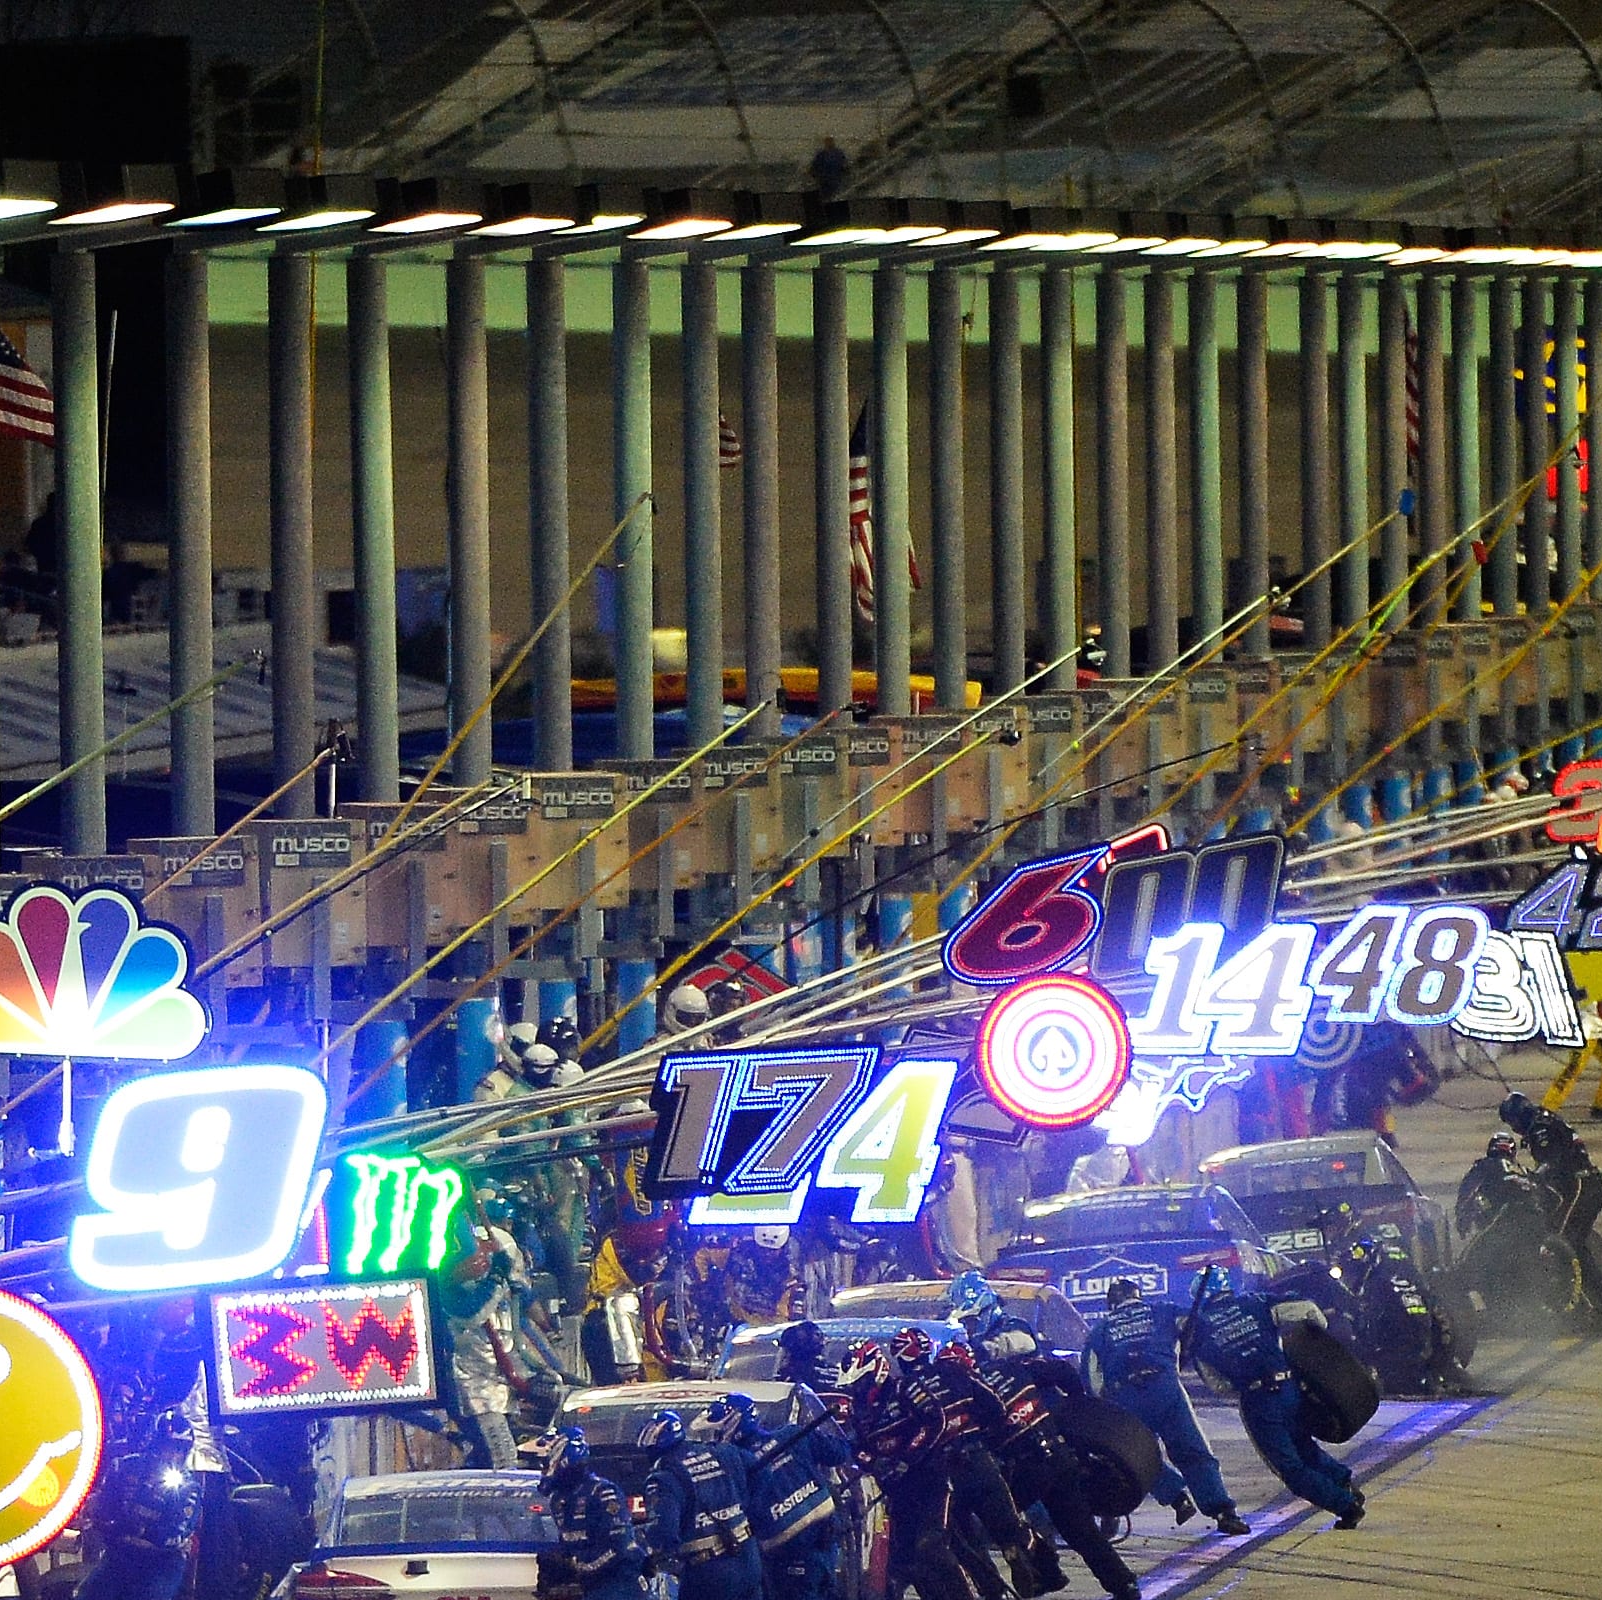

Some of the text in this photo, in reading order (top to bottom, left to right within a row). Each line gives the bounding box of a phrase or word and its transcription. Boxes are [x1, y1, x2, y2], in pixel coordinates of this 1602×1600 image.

[543, 790, 613, 806] MUSCO
[783, 749, 835, 763] USCO
[273, 836, 350, 853] MUSCO
[943, 843, 1112, 986] 6
[1310, 903, 1492, 1026] 48
[1131, 921, 1319, 1056] 14
[70, 1064, 328, 1292] 9
[650, 1044, 882, 1193] 17
